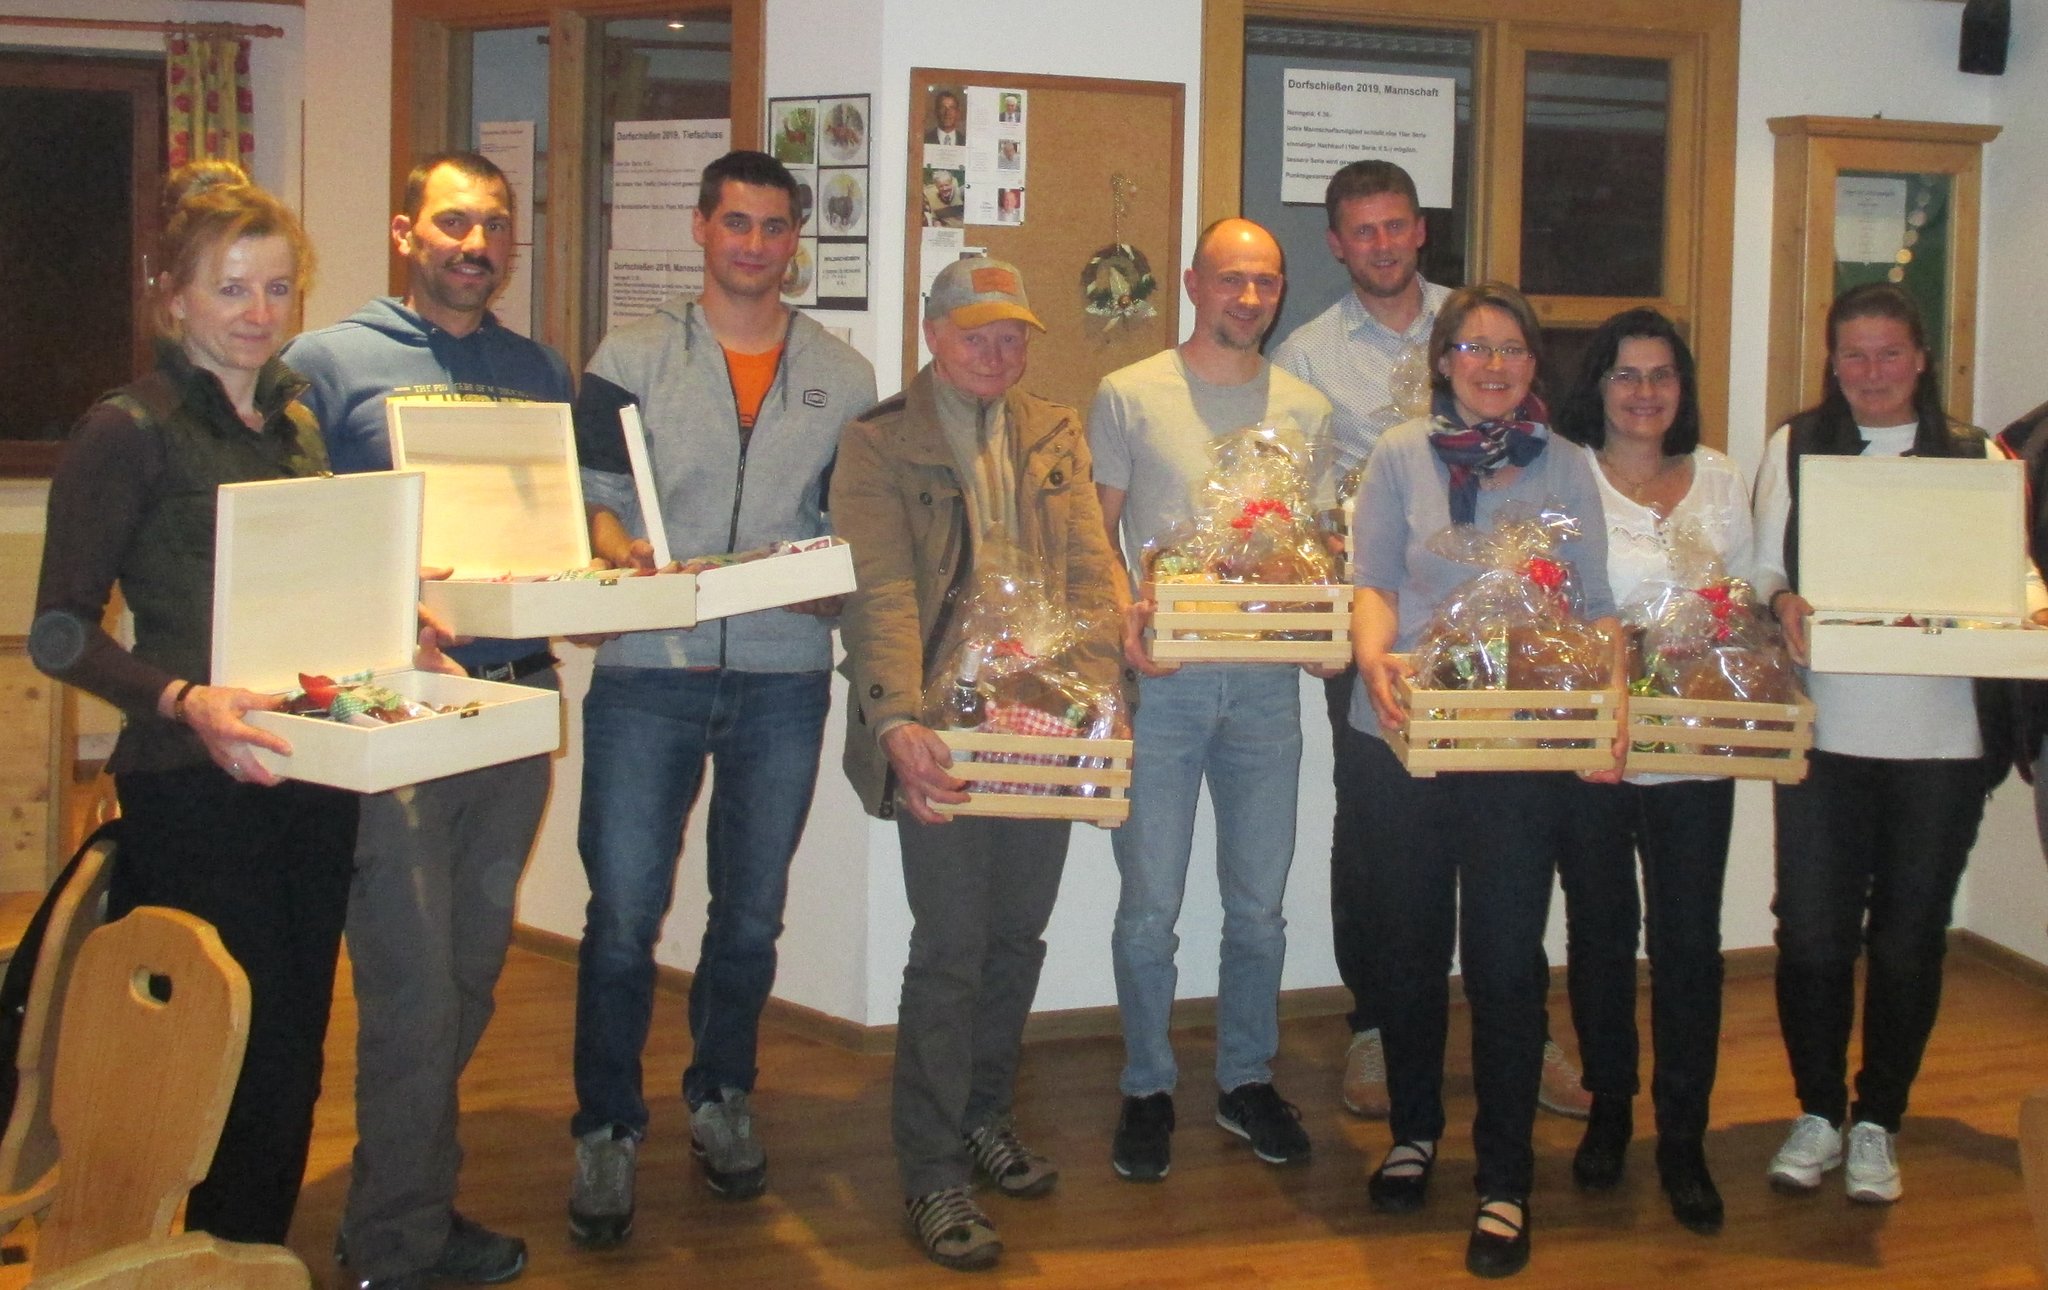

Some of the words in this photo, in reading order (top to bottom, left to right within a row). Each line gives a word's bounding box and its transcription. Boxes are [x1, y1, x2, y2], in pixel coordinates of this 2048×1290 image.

[1288, 79, 1353, 92] Dorfschießen
[1356, 83, 1382, 95] 2019,
[1384, 85, 1439, 97] Mannschaft
[413, 385, 431, 393] THE
